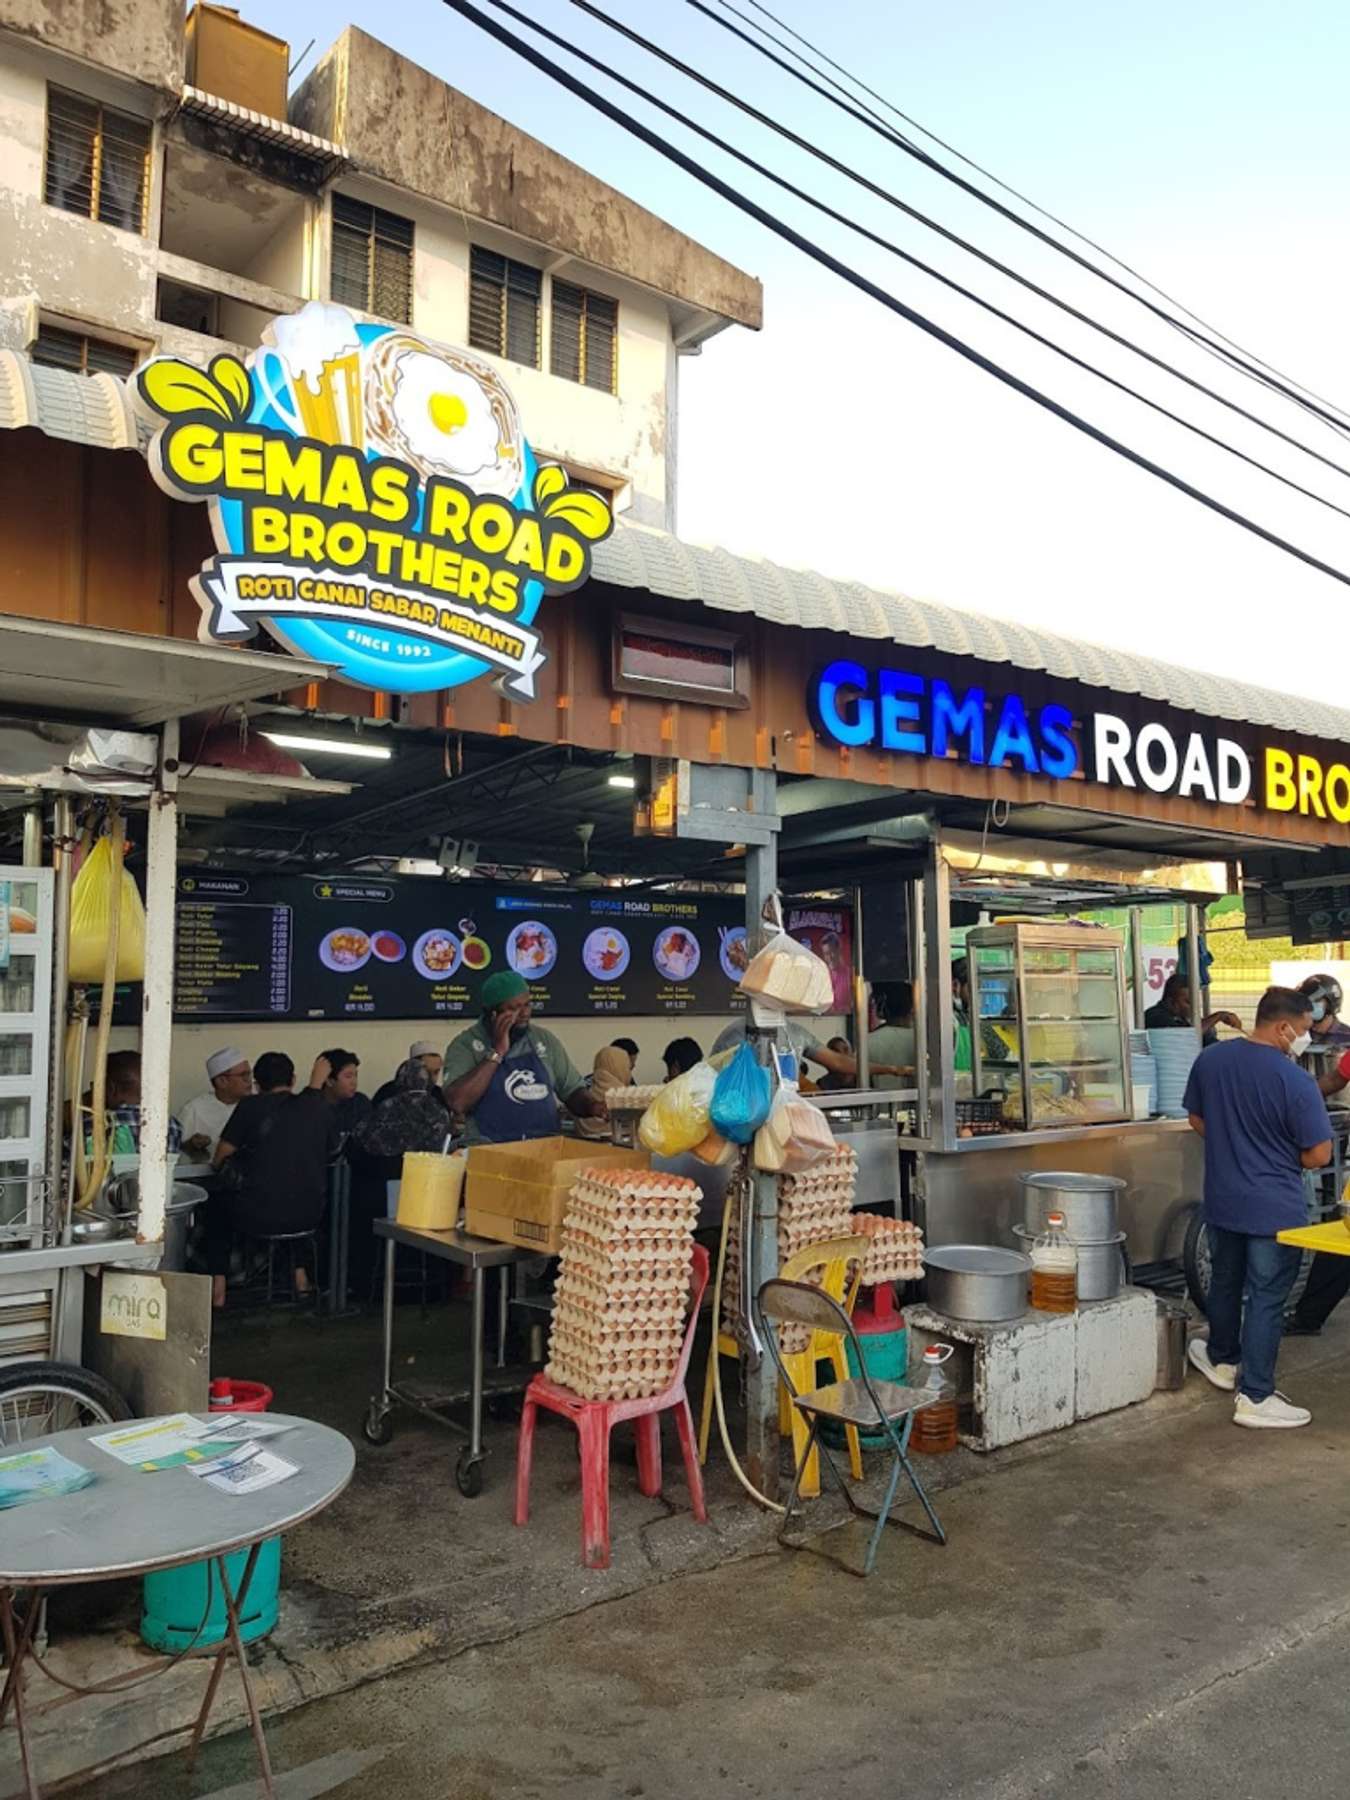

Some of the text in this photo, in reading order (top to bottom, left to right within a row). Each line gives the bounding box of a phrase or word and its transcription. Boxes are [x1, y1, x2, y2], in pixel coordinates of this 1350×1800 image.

[168, 422, 585, 584] GEMAS ROAD
[251, 507, 520, 614] BROTHERS
[238, 576, 525, 661] ROTI CANAI SABAR MENANTI
[346, 629, 431, 657] SINCE 1992
[817, 659, 1078, 779] GEMAS
[1093, 712, 1252, 805] ROAD
[336, 889, 364, 897] SPECIAL
[590, 900, 697, 914] GEMAS ROAD BROTHERS
[108, 1293, 160, 1320] mira
